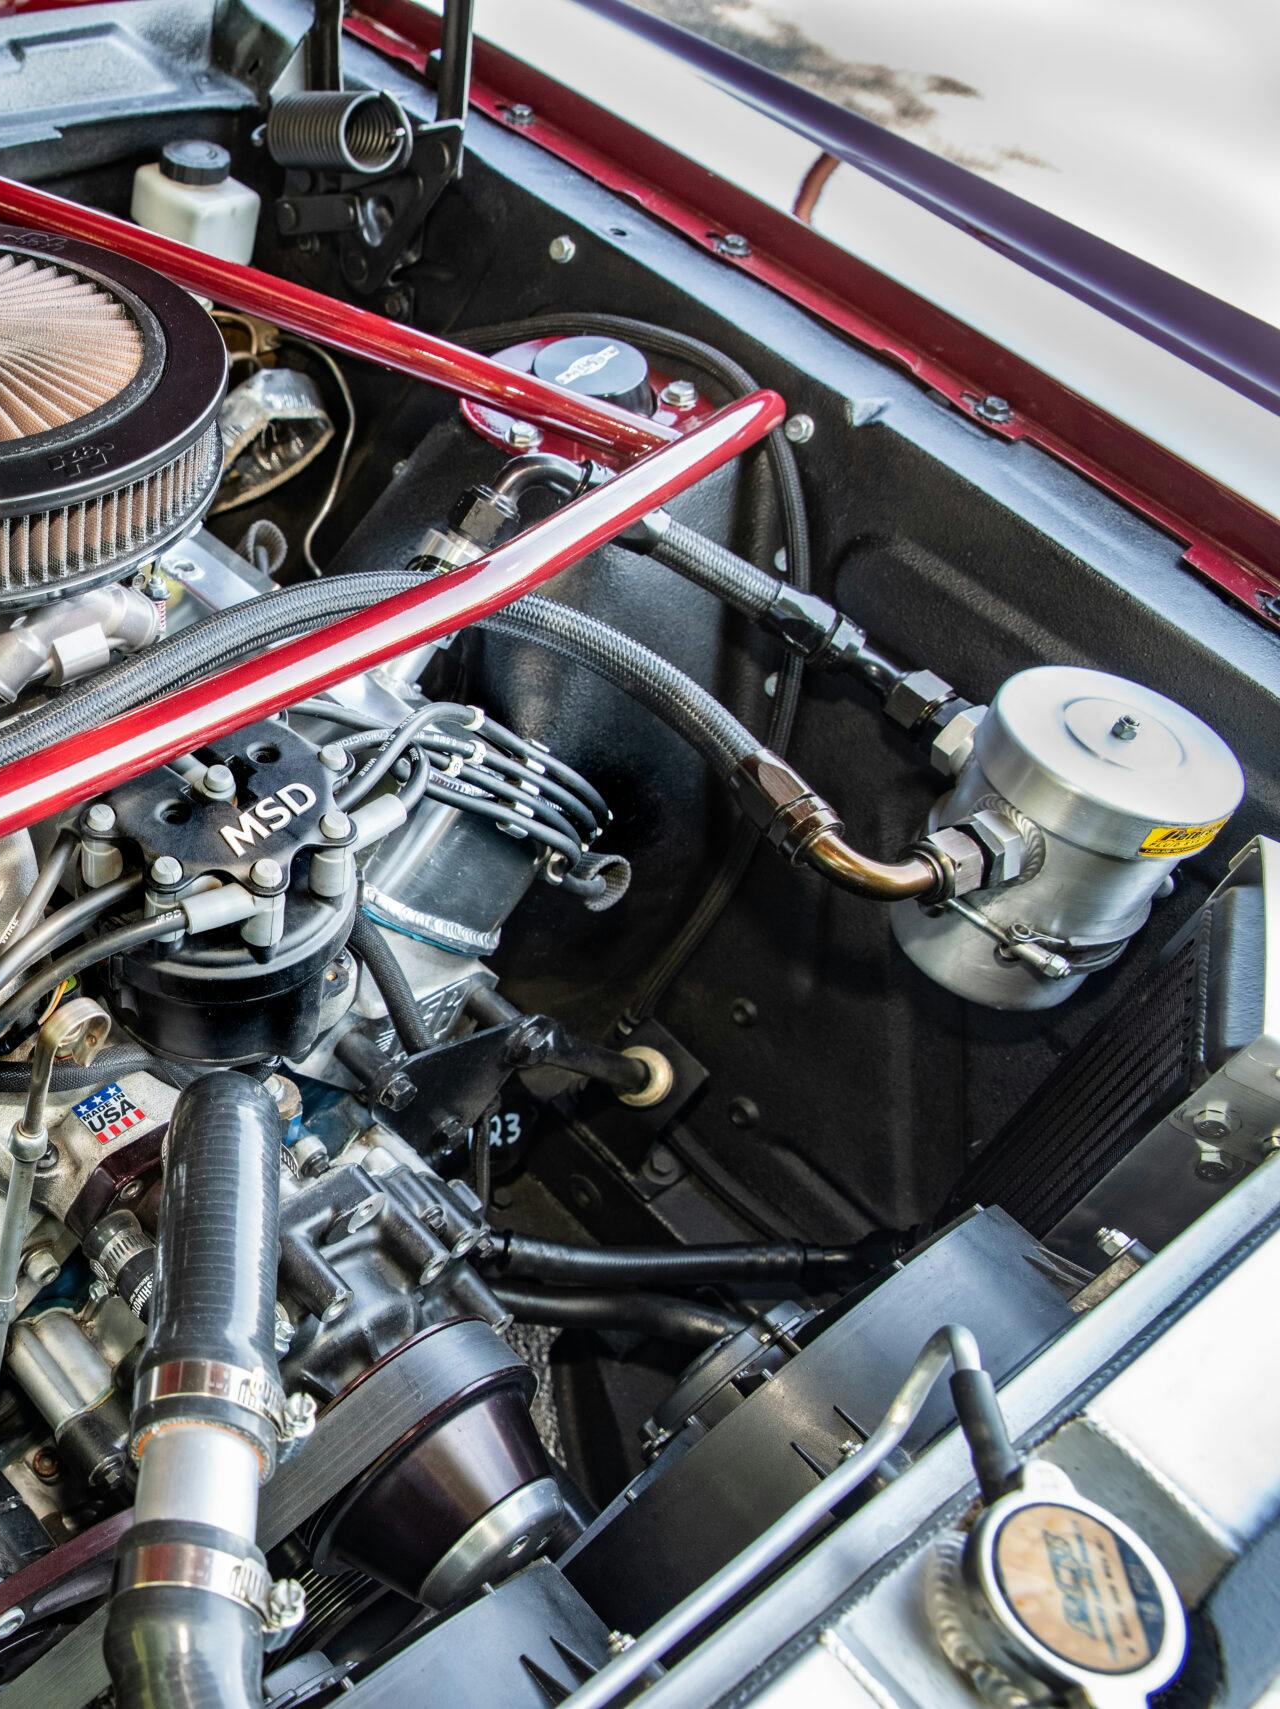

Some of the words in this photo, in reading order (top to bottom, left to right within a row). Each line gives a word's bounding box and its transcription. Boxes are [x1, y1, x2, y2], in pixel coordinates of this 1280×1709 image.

[357, 757, 378, 777] WIRE
[220, 782, 317, 858] MSD
[81, 1100, 113, 1122] MADE
[112, 1092, 126, 1103] IN
[87, 1098, 137, 1133] USA
